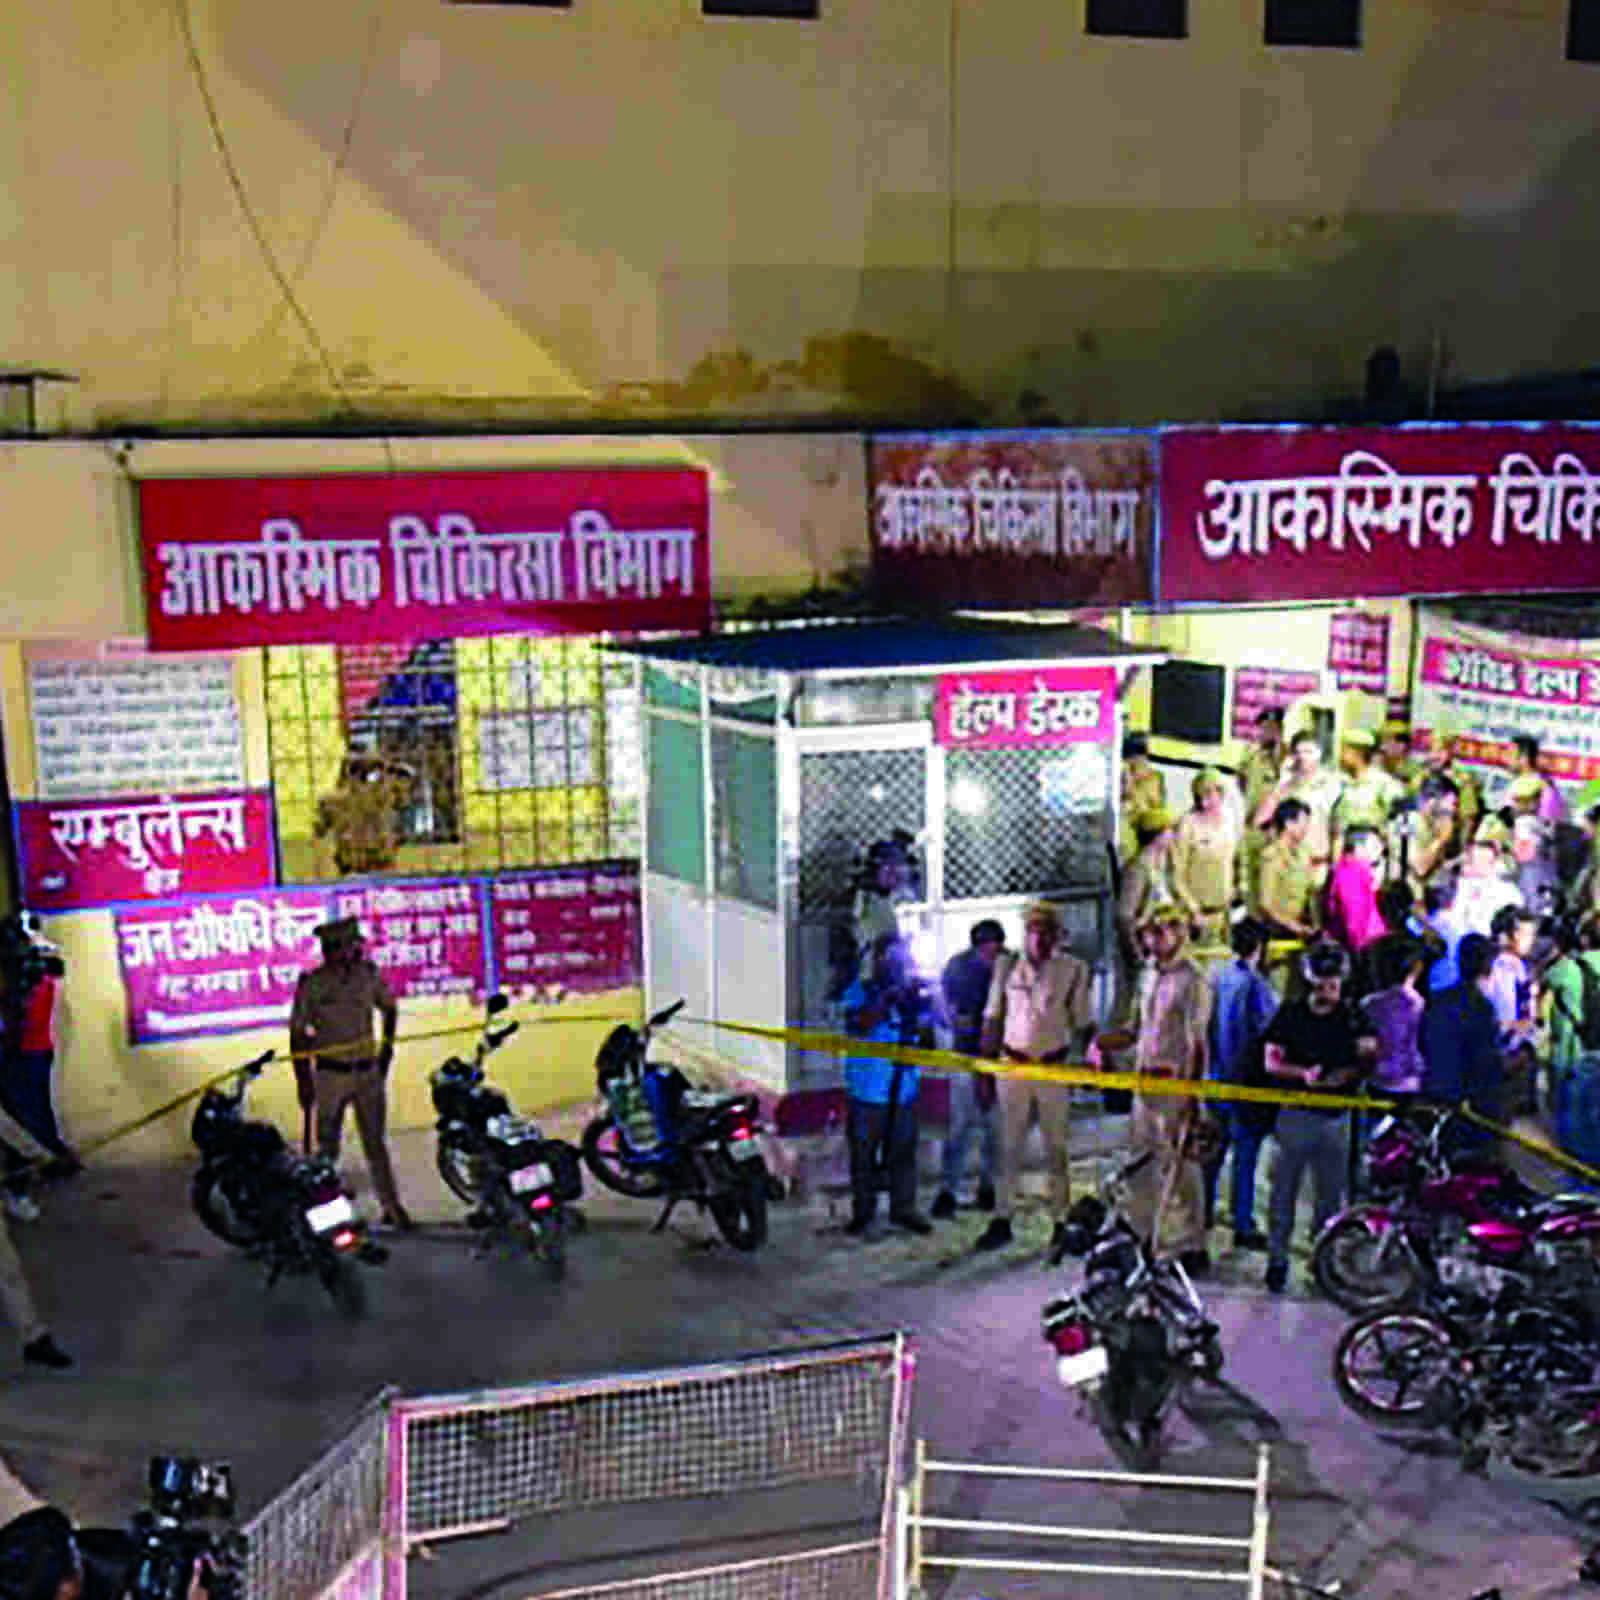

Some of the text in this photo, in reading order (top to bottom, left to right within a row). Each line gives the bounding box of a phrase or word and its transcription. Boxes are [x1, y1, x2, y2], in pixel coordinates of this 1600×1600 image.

[1197, 451, 1478, 557] आकस्मिक
[158, 509, 696, 615] आकस्मिक चिकित्सा विभाग
[119, 920, 173, 967] जन
